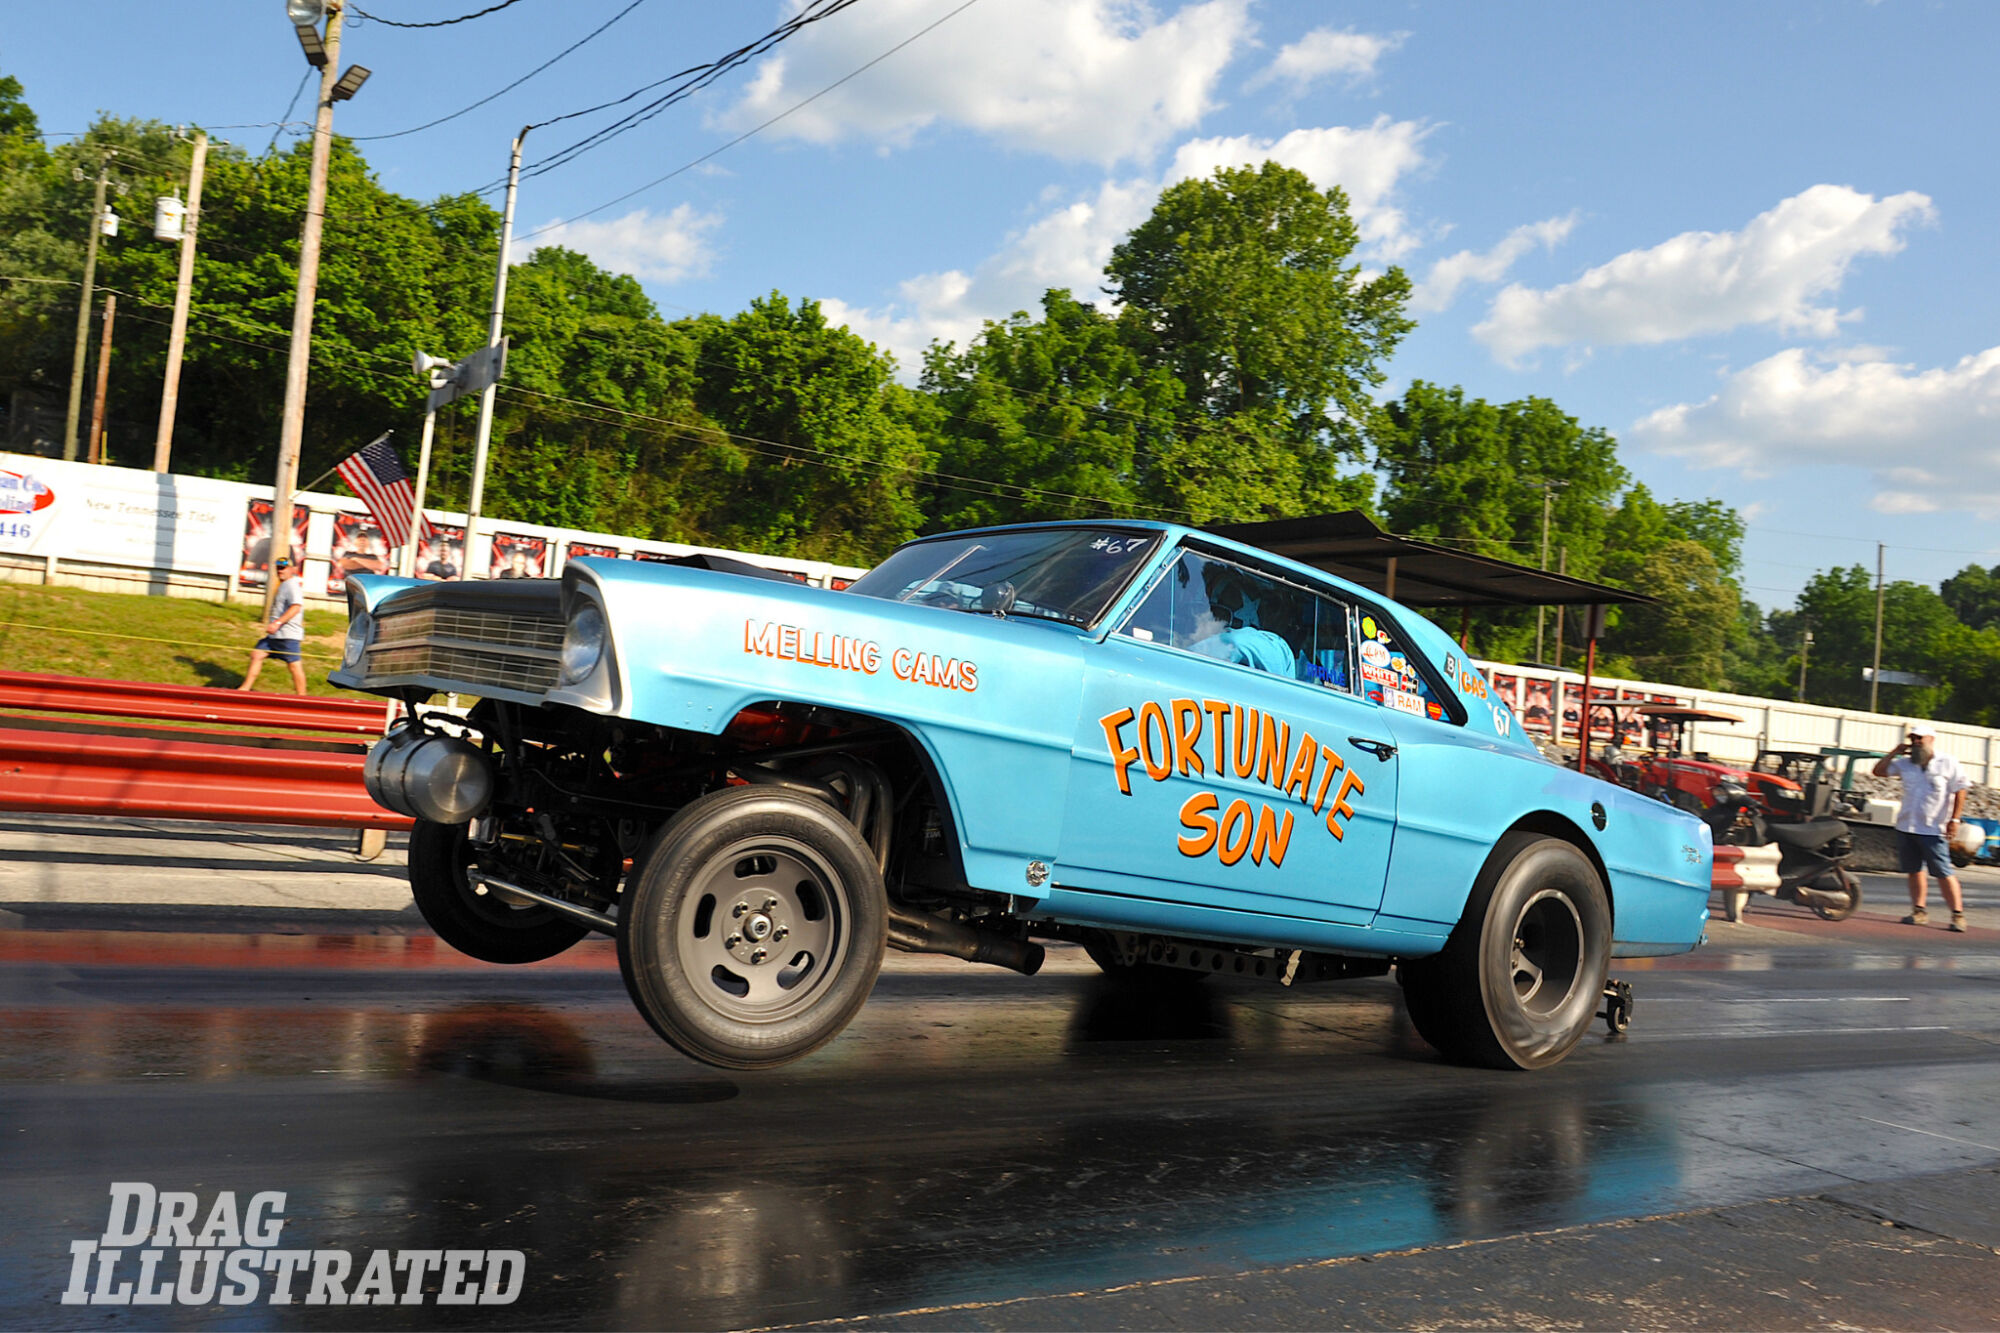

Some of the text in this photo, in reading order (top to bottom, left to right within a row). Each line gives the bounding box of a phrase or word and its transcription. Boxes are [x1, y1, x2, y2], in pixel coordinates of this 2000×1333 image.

[1089, 536, 1148, 554] #67
[744, 618, 979, 692] MELLING CAMS
[1397, 694, 1422, 713] RAM
[1099, 698, 1365, 842] FORTUNATE
[1177, 791, 1295, 869] SON
